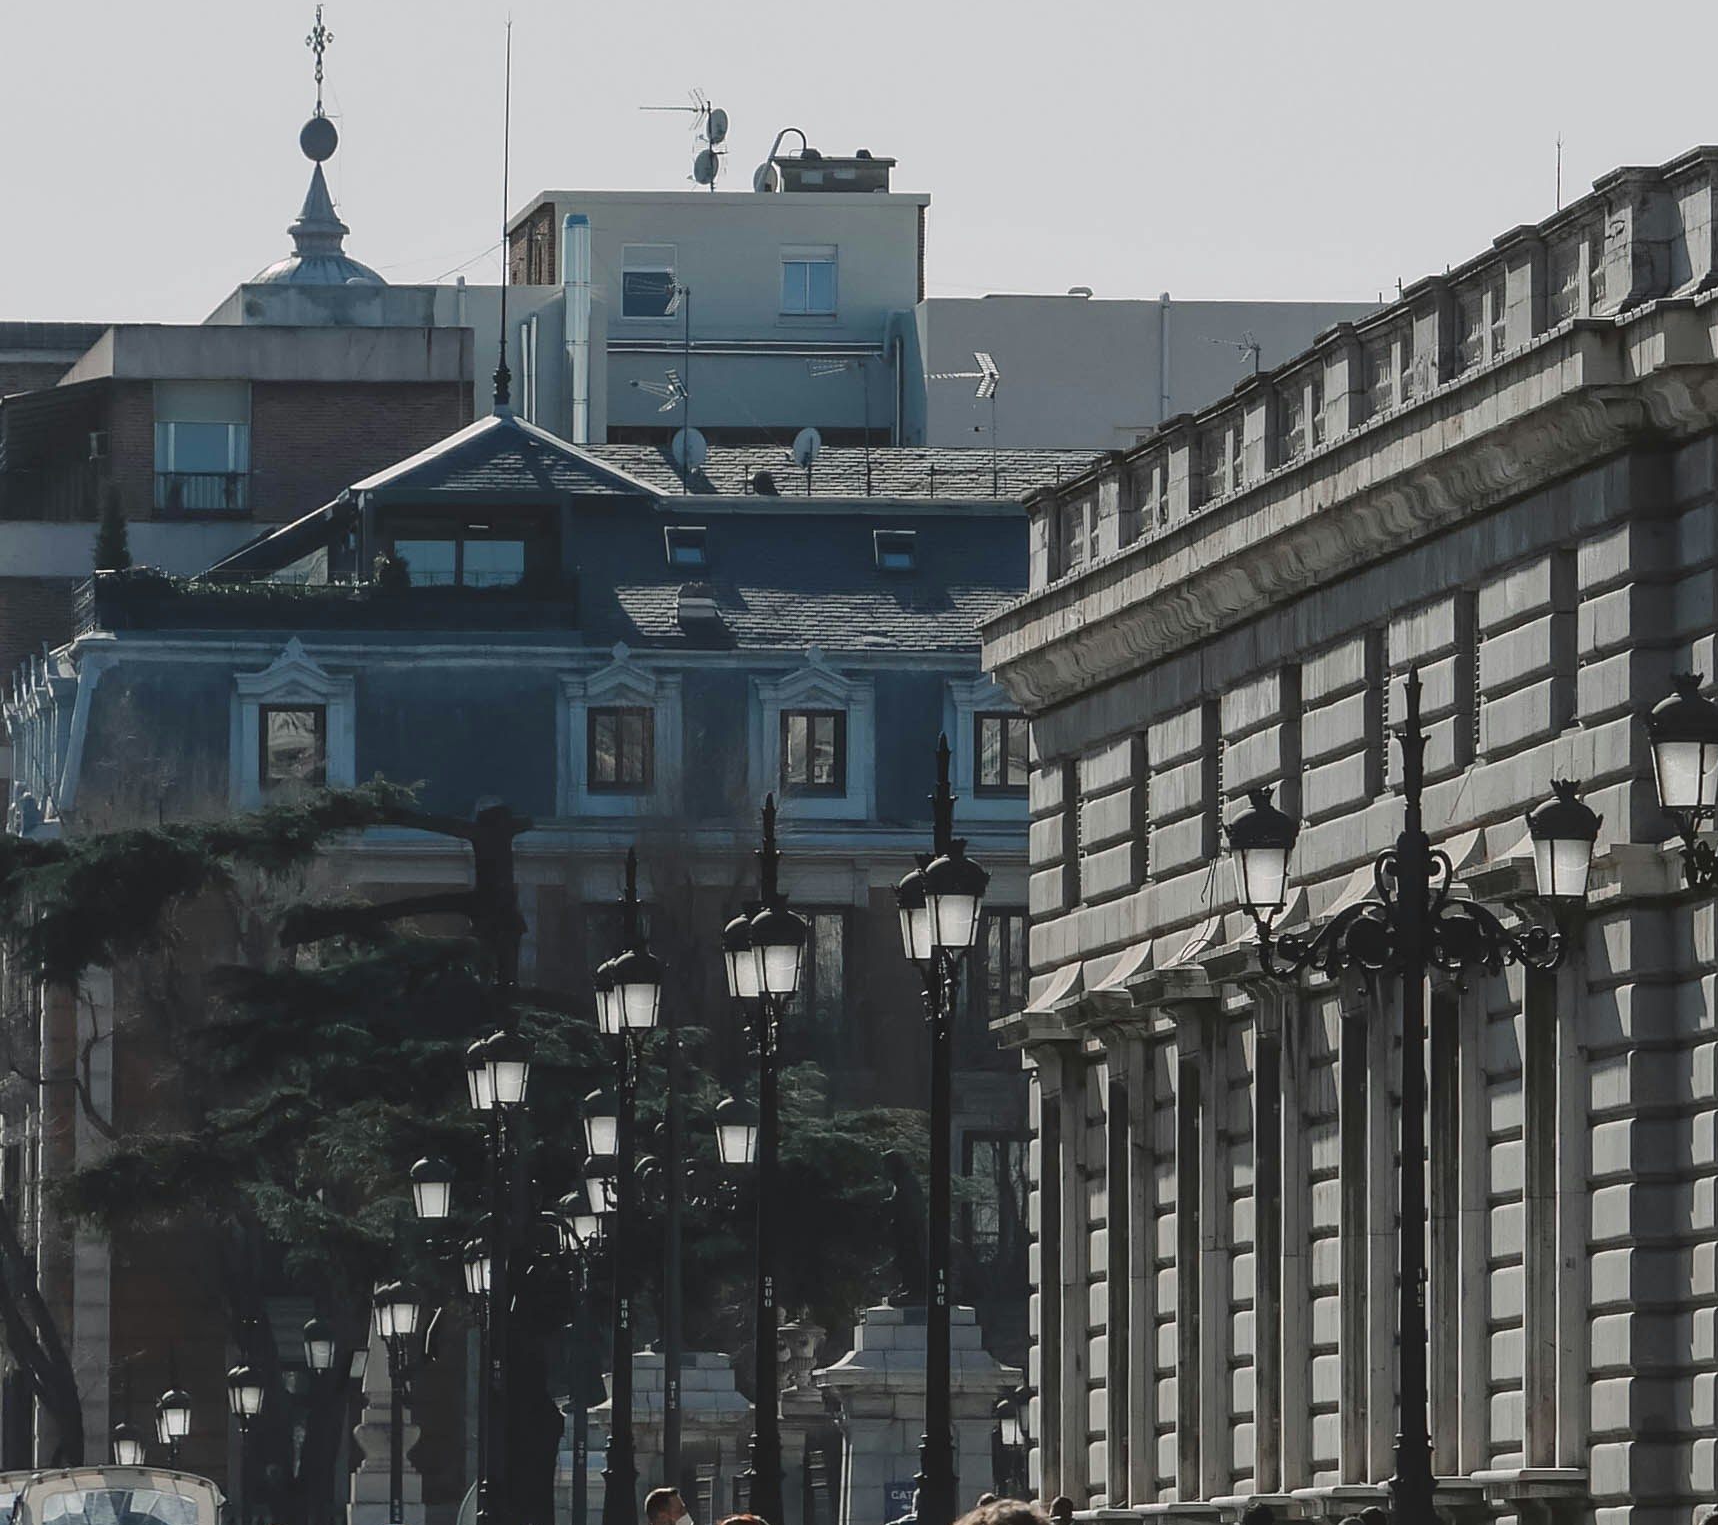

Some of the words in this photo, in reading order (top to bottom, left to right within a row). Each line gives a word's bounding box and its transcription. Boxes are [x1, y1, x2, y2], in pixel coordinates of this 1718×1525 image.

[764, 1276, 772, 1308] 200
[936, 1268, 944, 1306] 196
[619, 1299, 628, 1329] 204
[891, 1490, 913, 1500] CAT
